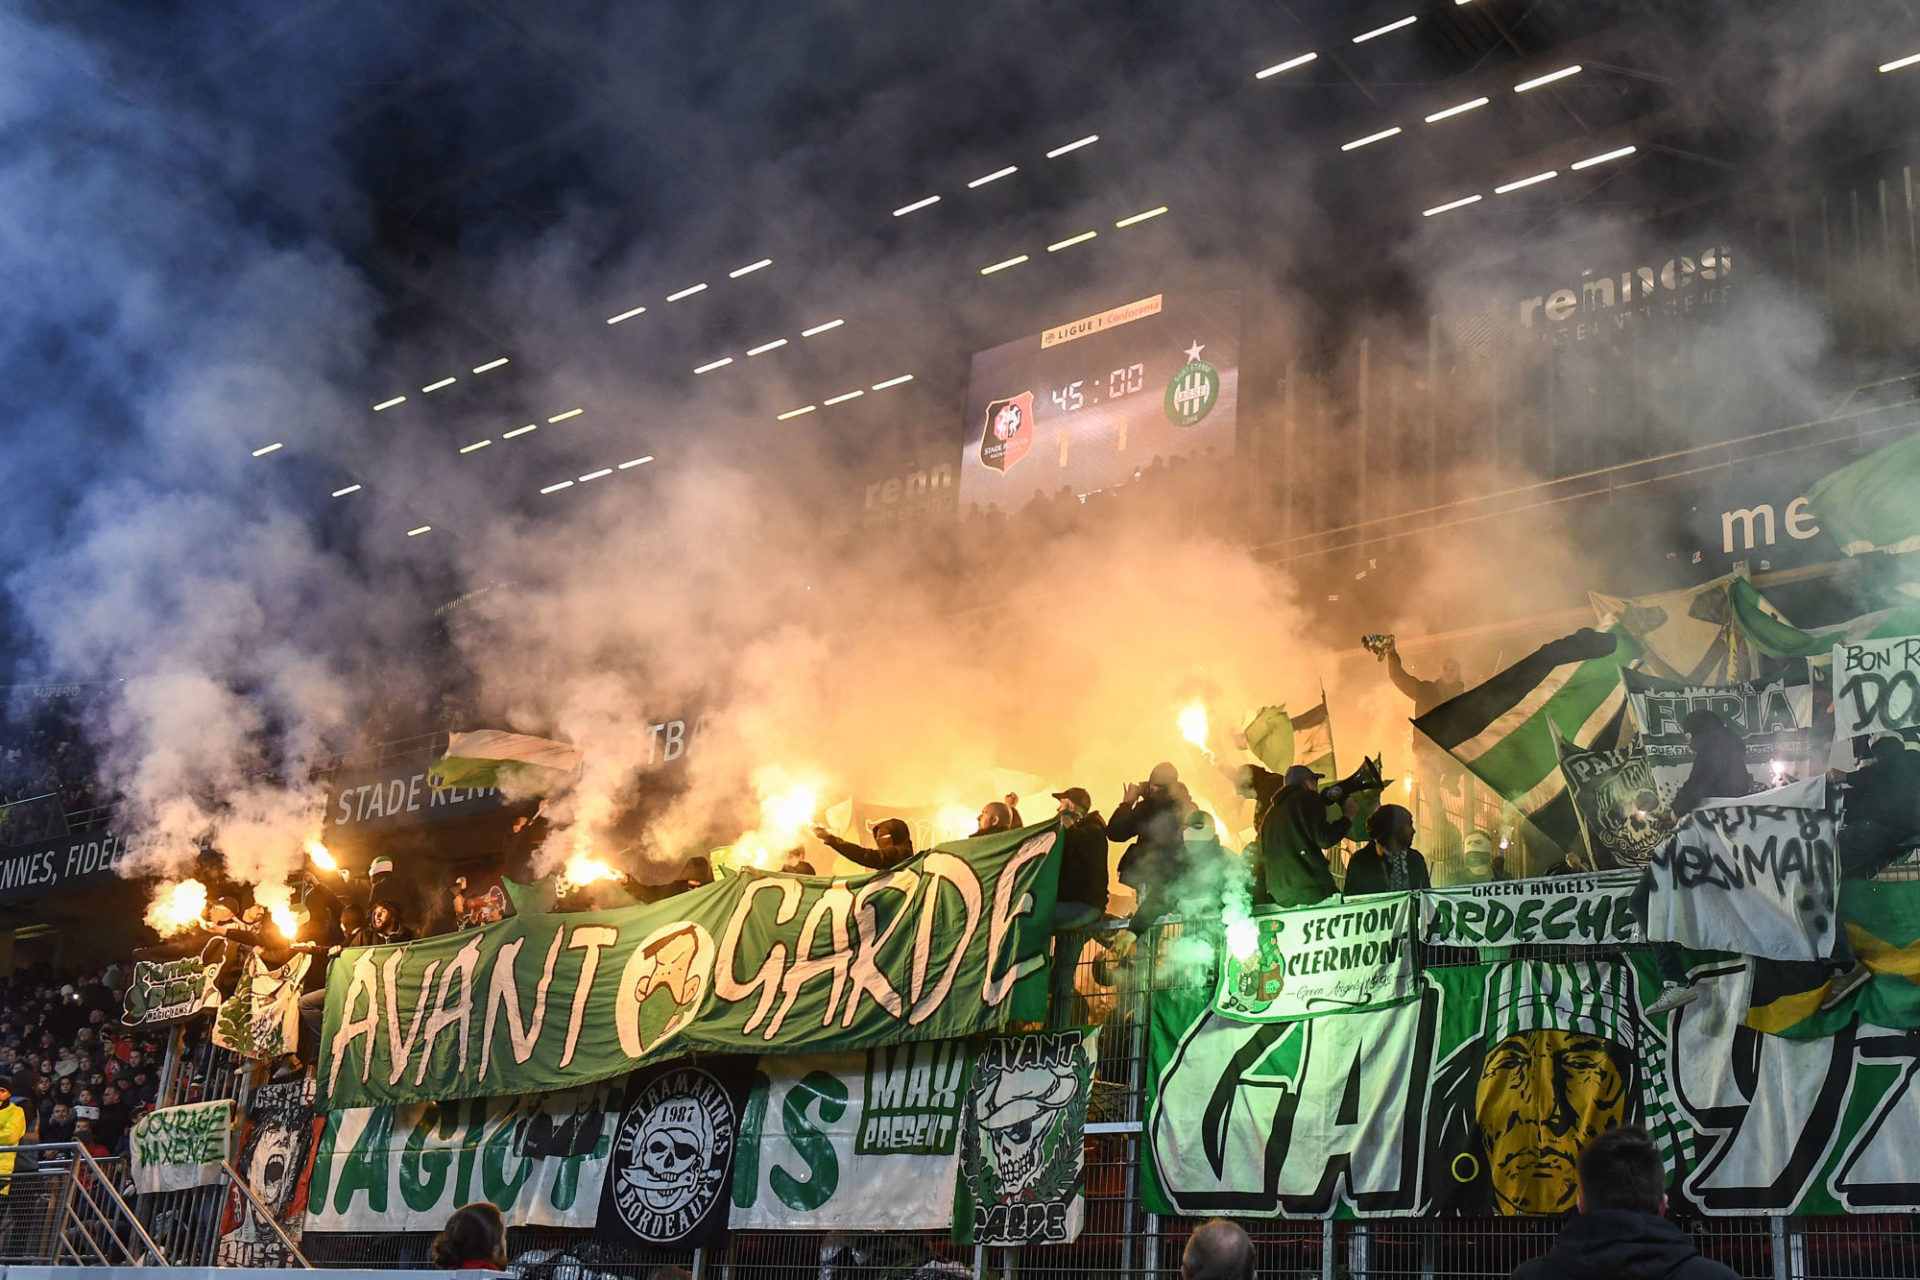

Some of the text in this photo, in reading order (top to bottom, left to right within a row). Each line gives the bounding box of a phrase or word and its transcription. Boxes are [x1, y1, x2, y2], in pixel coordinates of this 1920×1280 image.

[1058, 301, 1160, 340] LIGUE 1 Conforama
[1844, 645, 1891, 672] BON
[1644, 690, 1798, 738] FRIA
[334, 773, 425, 826] STADE
[0, 851, 57, 889] NNES,
[1471, 879, 1594, 897] GREEN ANGELS
[1303, 903, 1399, 945] SECTION
[1425, 895, 1637, 944] ARDECHE
[328, 830, 1058, 1099] AVANT GARDE
[1287, 931, 1408, 977] CLERMONT
[984, 1031, 1082, 1071] AVANT
[870, 1041, 965, 1110] MAX
[136, 1106, 227, 1139] COURAGE
[619, 1072, 732, 1156] ULTRAMARINES
[661, 1106, 695, 1122] 1987
[863, 1114, 953, 1150] PRESENT
[617, 1178, 714, 1237] BORDEAUX
